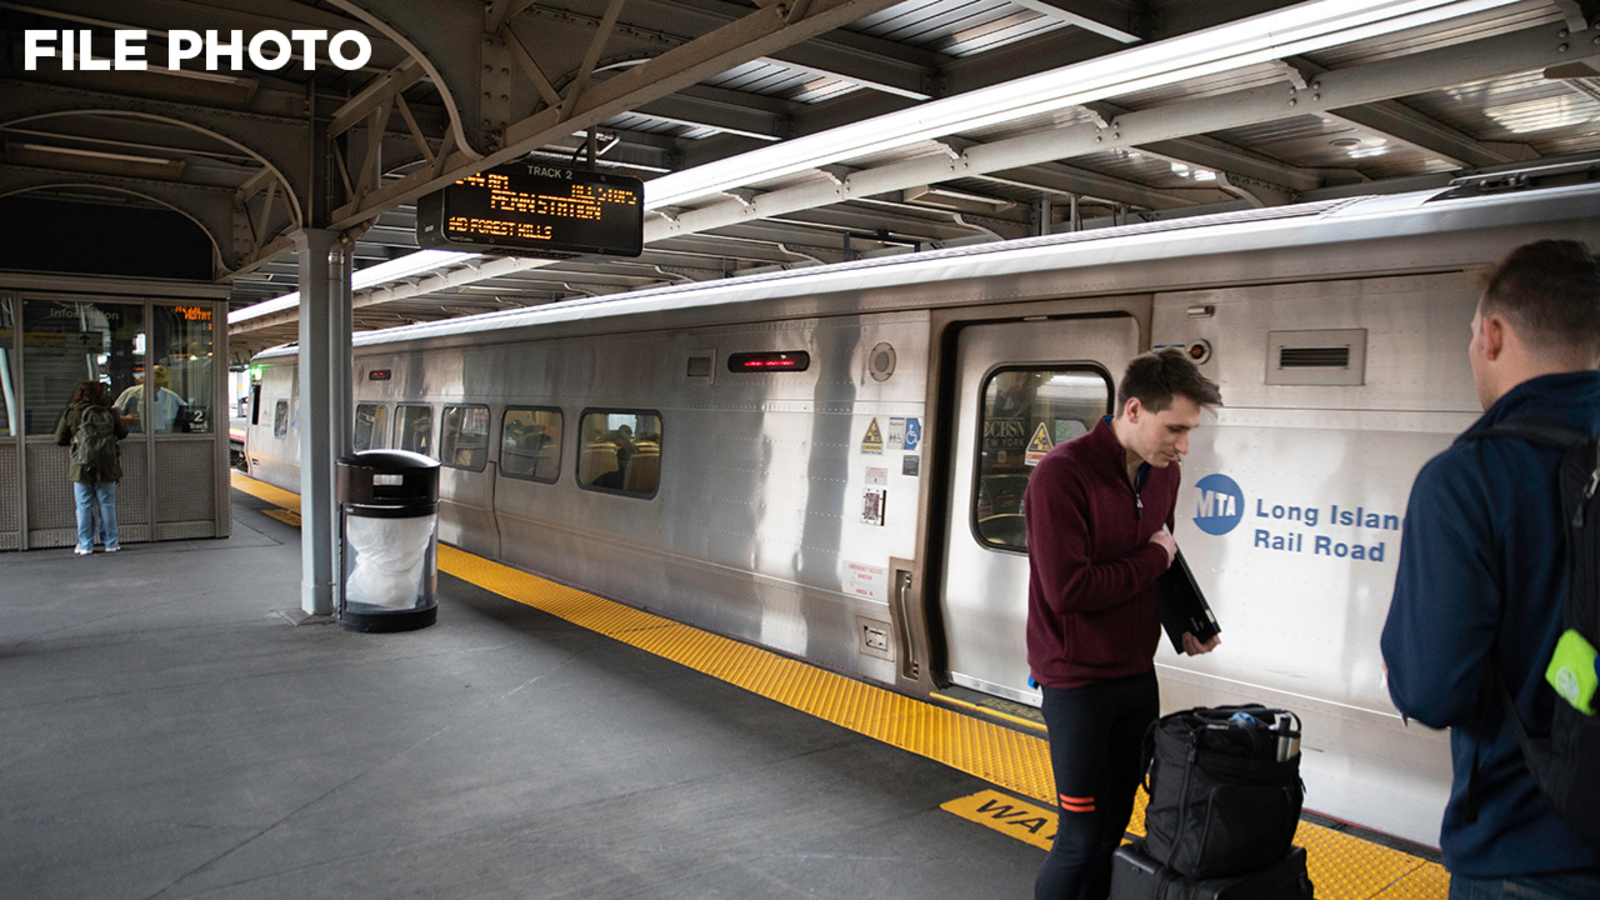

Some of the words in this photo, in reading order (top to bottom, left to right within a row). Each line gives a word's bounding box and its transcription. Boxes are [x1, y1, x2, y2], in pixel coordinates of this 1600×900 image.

[527, 165, 562, 179] TRACK
[566, 170, 573, 180] 2
[491, 189, 536, 214] PENN
[537, 194, 601, 221] STATION
[470, 218, 516, 237] FOREST
[518, 222, 552, 240] HILLS
[50, 308, 119, 320] Infoon
[194, 410, 204, 422] 2
[1196, 488, 1237, 518] MTA
[1256, 498, 1319, 527] Long
[1331, 504, 1405, 531] Islan
[1254, 528, 1303, 553] Rail
[1314, 535, 1386, 563] Road
[976, 799, 1056, 840] WA
